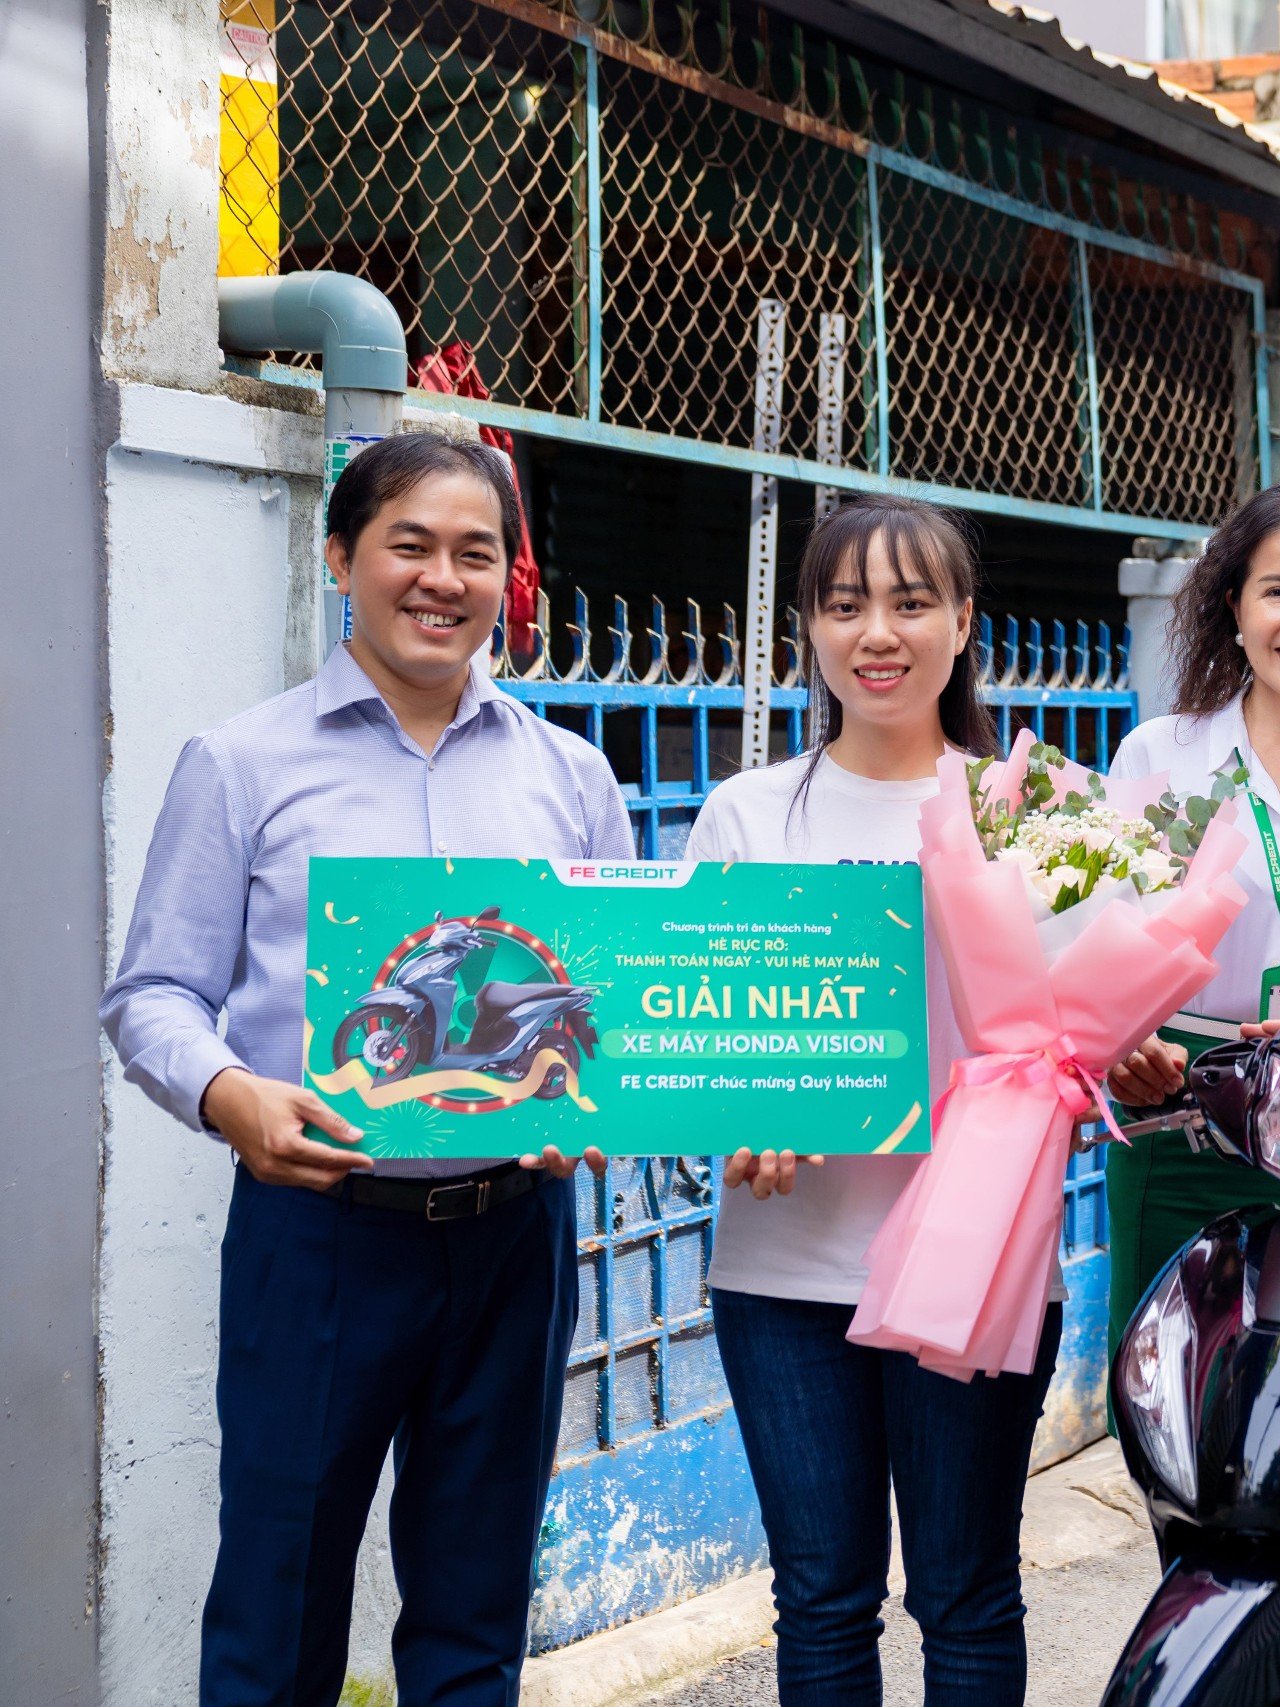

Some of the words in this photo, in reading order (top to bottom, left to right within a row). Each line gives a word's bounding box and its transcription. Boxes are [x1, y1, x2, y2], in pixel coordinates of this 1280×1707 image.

[1262, 831, 1280, 875] CREDIT
[570, 867, 596, 878] FE
[600, 867, 678, 879] CREDIT
[661, 921, 706, 934] Chương
[751, 922, 766, 933] ân
[767, 922, 801, 933] khách
[803, 923, 832, 935] hàng
[708, 936, 728, 951] HÈ
[615, 954, 666, 967] THANH
[669, 952, 709, 967] TOÁN
[713, 955, 752, 968] NGAY
[764, 956, 789, 968] VUI
[792, 954, 811, 968] HÈ
[814, 956, 845, 968] MAY
[847, 951, 880, 969] MẮN
[641, 974, 732, 1019] GIẢI
[748, 974, 866, 1019] NHẤT
[622, 1034, 652, 1053] XE
[659, 1030, 709, 1053] MÁY
[715, 1034, 800, 1054] HONDA
[805, 1034, 885, 1054] VISION
[620, 1074, 642, 1089] FE
[645, 1074, 707, 1089] CREDIT
[710, 1075, 748, 1089] chúc
[751, 1074, 796, 1092] mừng
[800, 1074, 833, 1092] Quý
[836, 1074, 887, 1089] khách!
